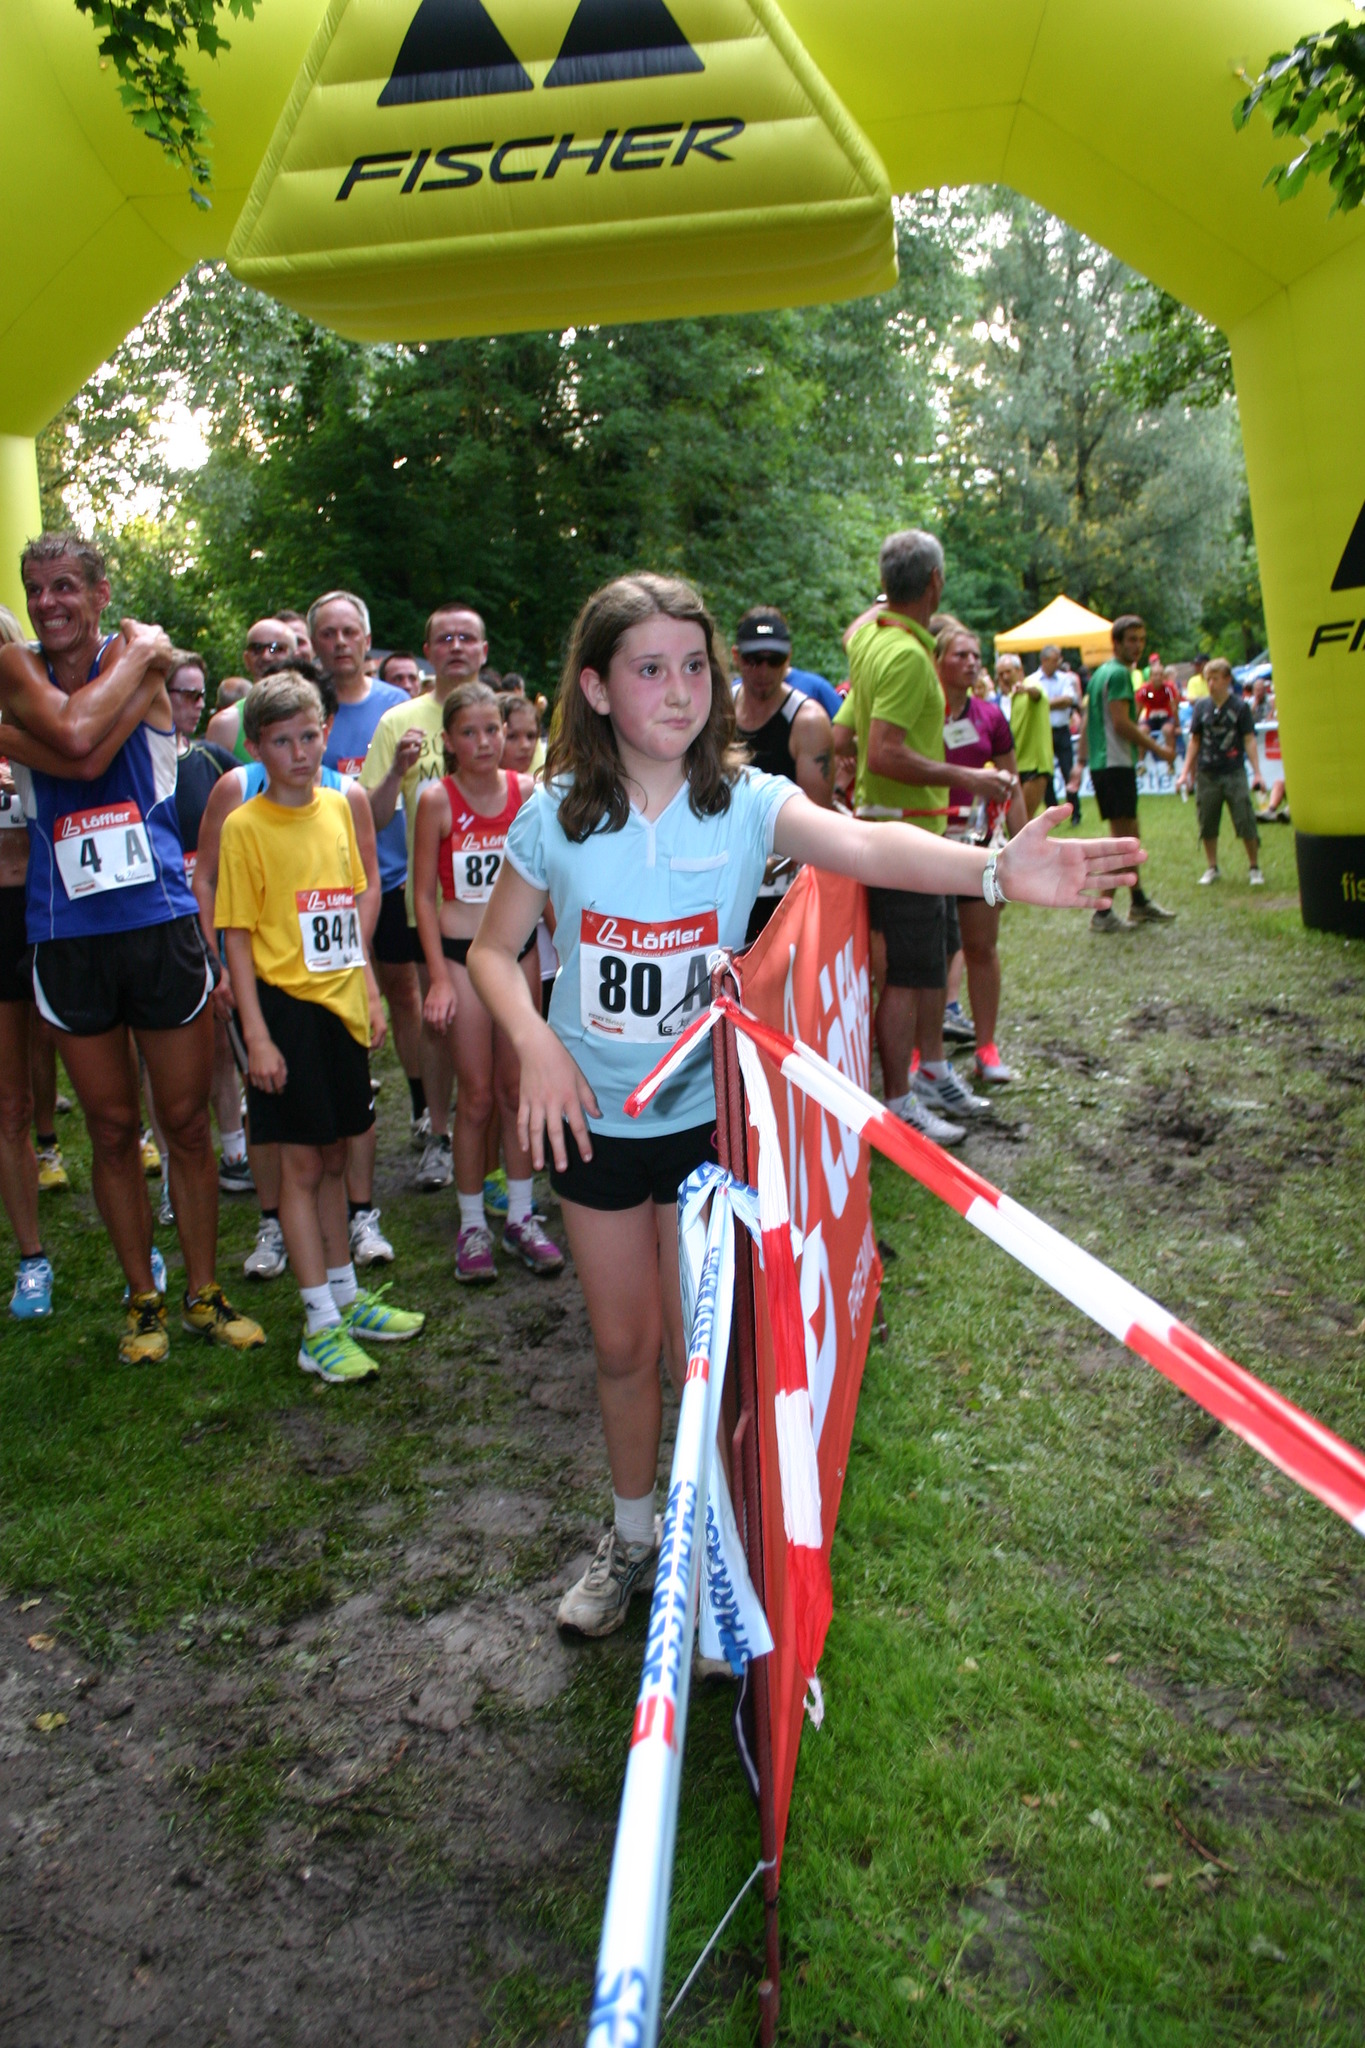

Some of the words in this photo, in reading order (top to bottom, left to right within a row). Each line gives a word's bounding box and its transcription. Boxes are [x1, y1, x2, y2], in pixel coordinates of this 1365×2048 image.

[335, 116, 746, 202] FISCHER
[1308, 618, 1365, 658] FI
[80, 837, 102, 873] 4
[125, 829, 148, 866] A
[465, 854, 501, 886] 82
[311, 915, 343, 952] 84
[631, 926, 704, 950] Löffler
[599, 955, 662, 1018] 80
[681, 954, 711, 1013] A
